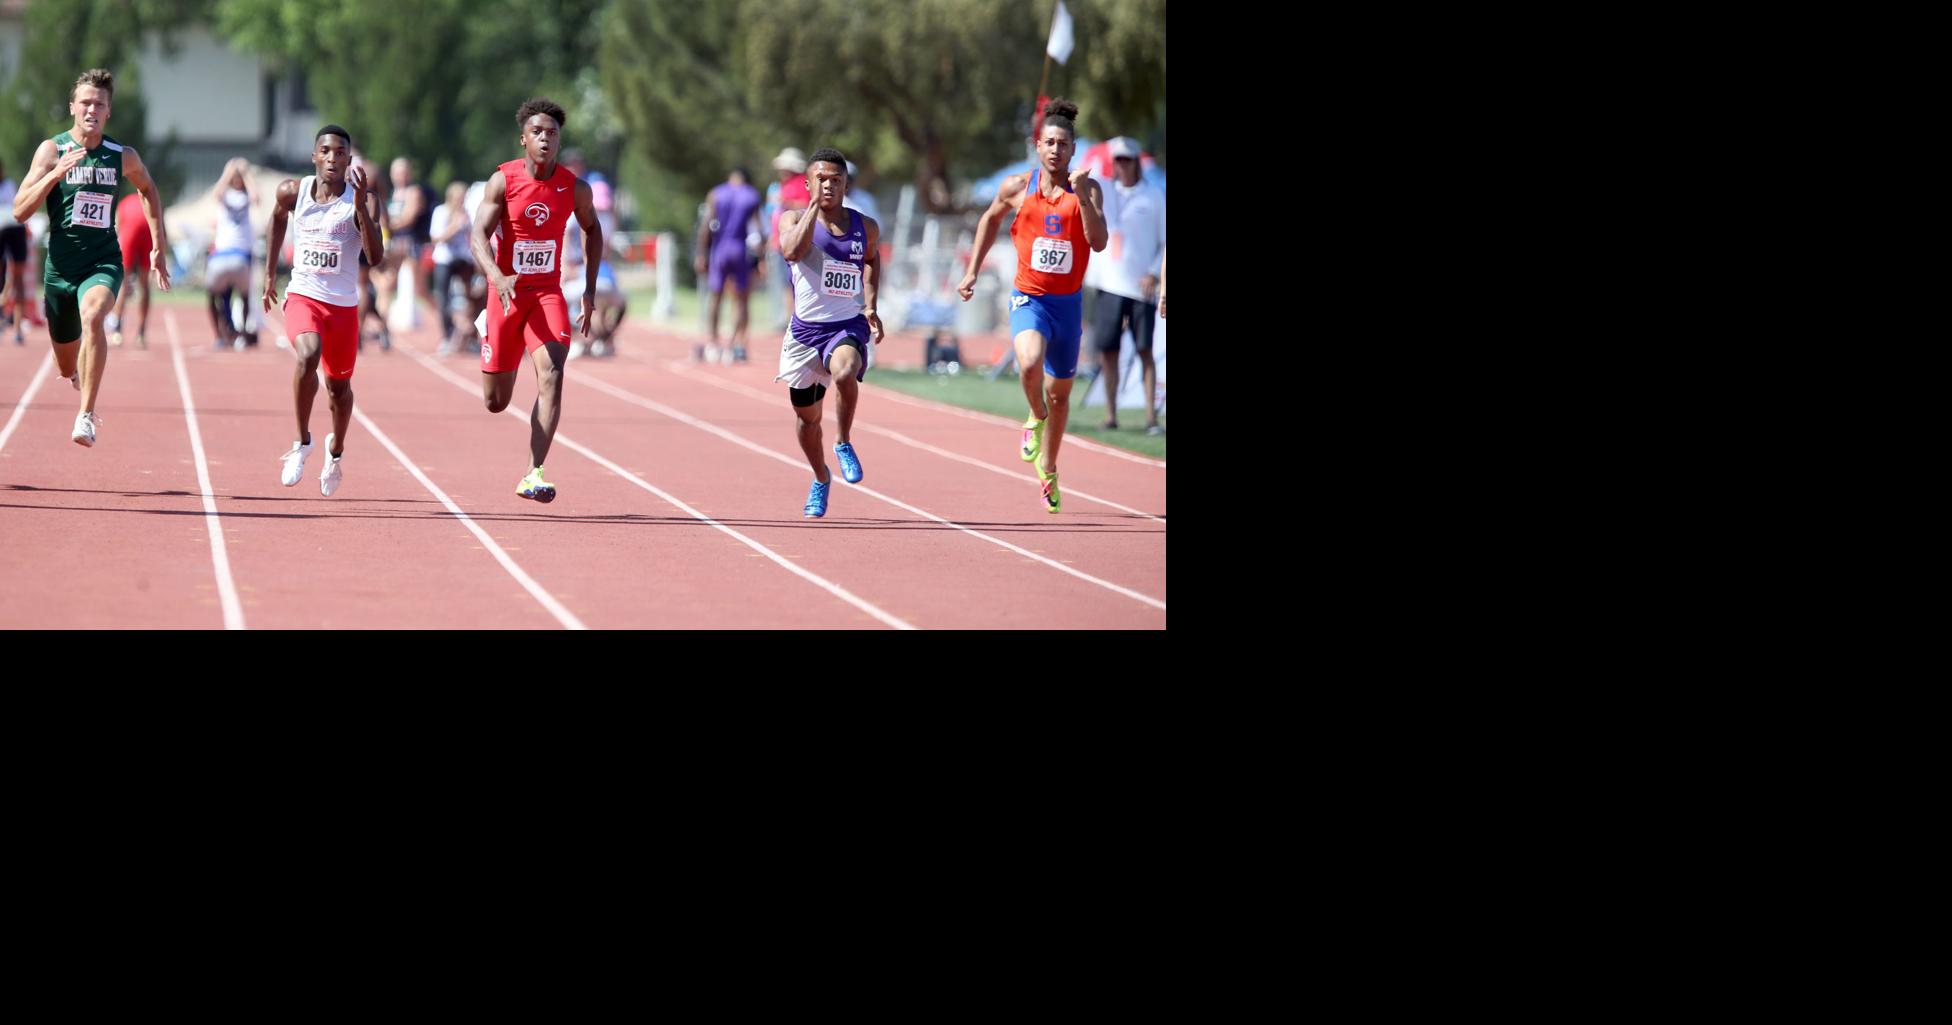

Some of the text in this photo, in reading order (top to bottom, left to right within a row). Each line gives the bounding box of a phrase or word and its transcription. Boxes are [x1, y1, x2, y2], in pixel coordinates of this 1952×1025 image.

[66, 166, 117, 185] CAMPO VERDE
[80, 202, 104, 220] 421
[1044, 214, 1061, 235] S
[302, 249, 338, 268] 2300
[517, 250, 552, 267] 1467
[1039, 249, 1067, 265] 367
[824, 271, 856, 290] 3031
